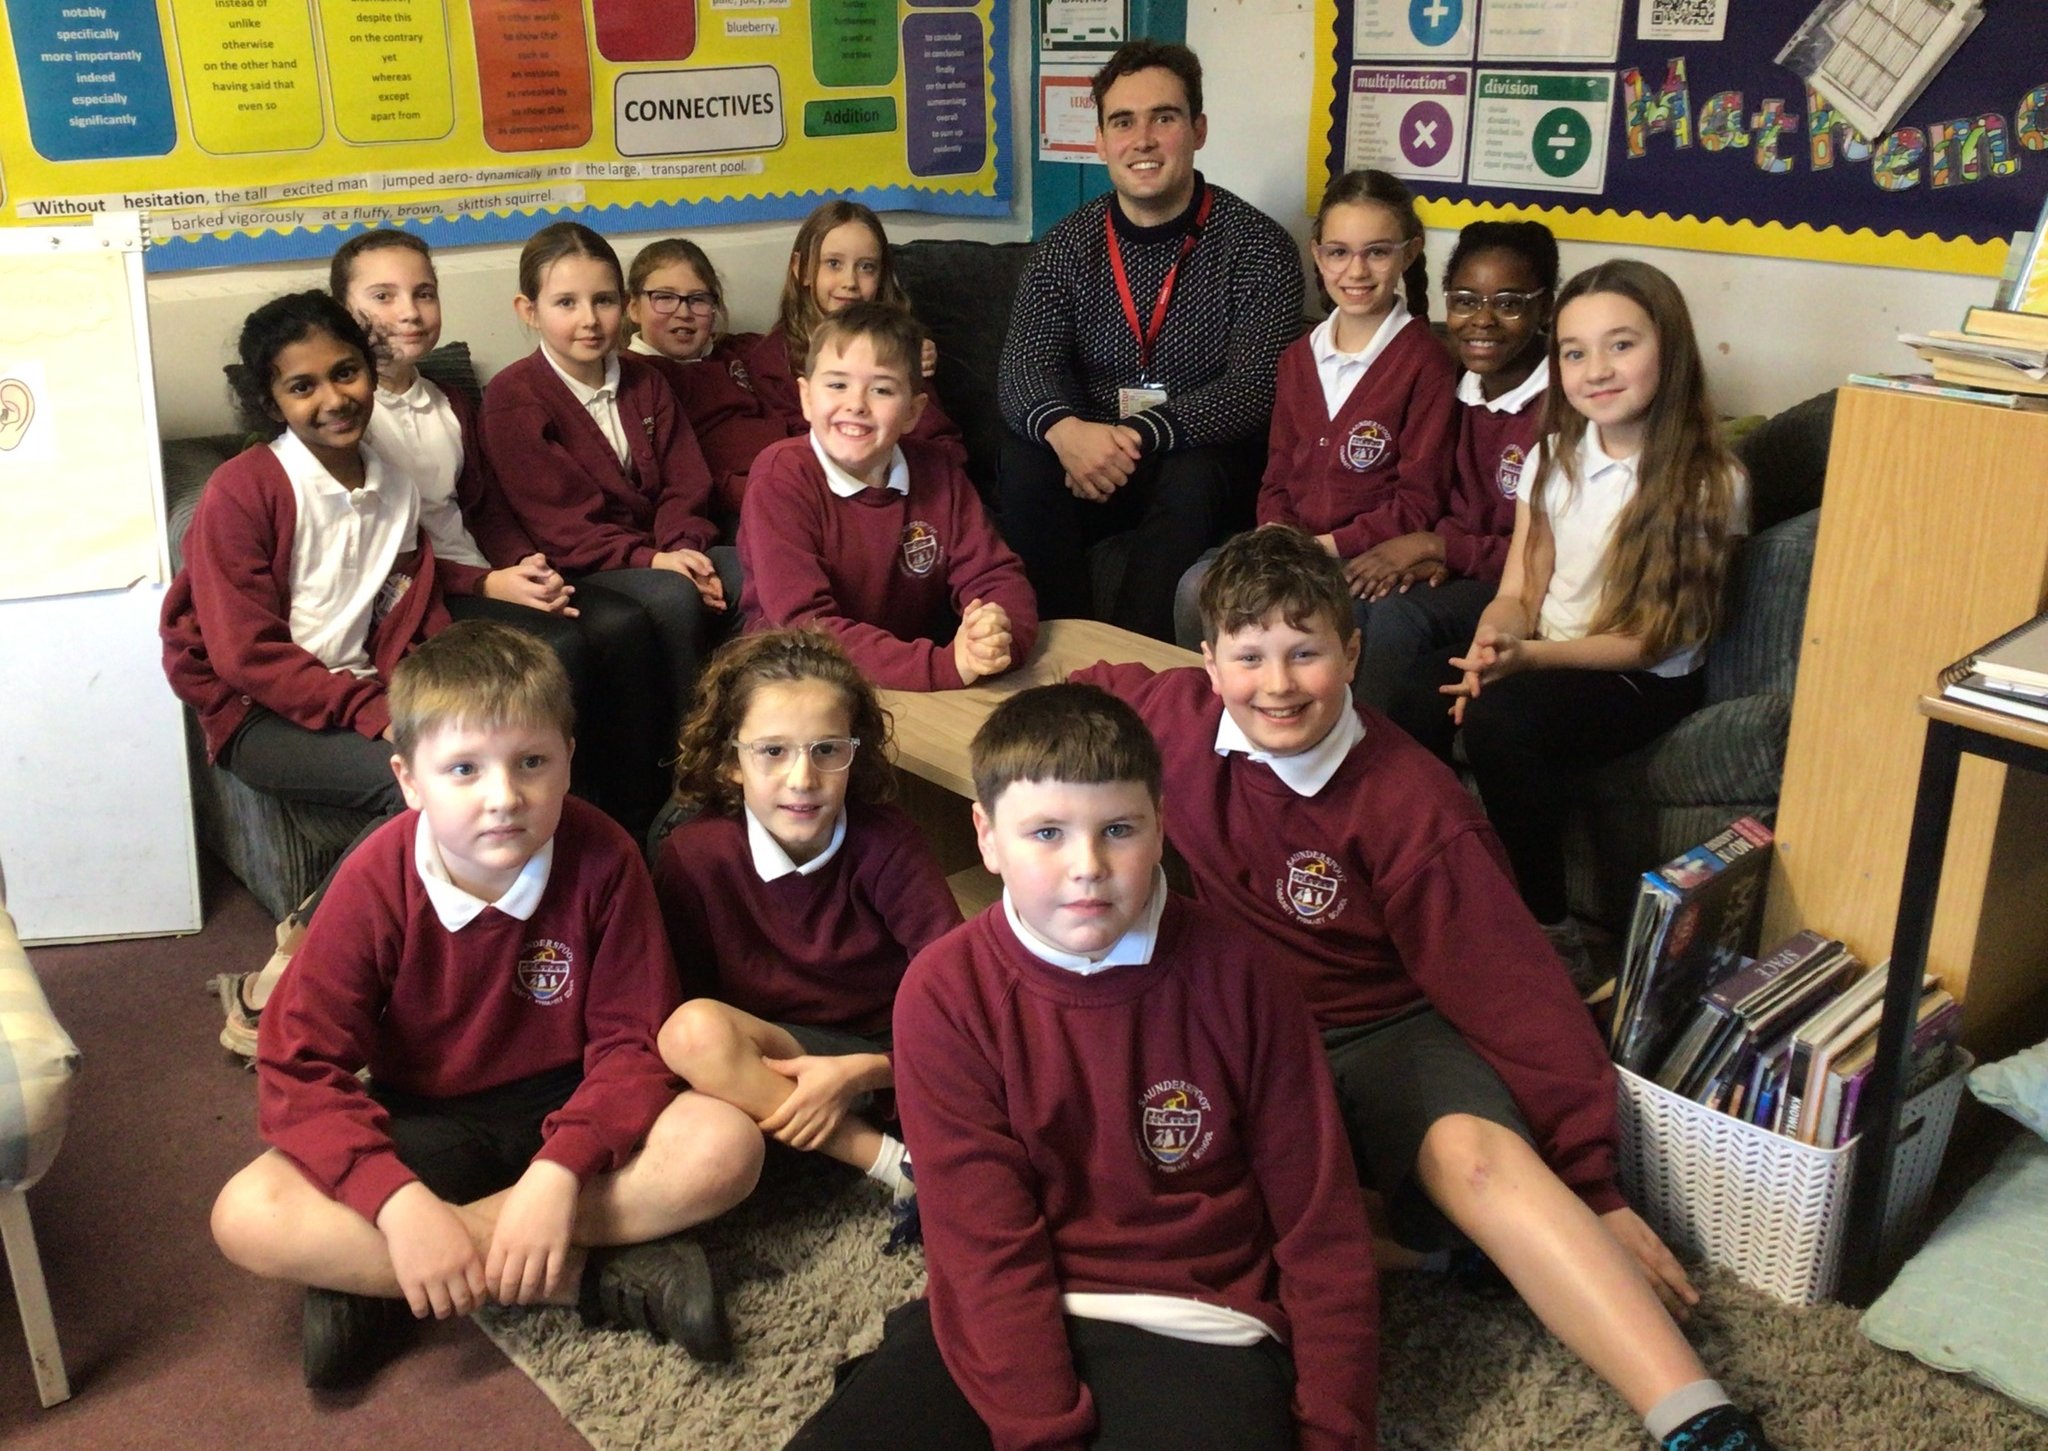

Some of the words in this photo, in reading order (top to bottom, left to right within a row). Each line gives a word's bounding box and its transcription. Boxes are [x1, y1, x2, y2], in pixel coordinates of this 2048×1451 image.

[62, 7, 106, 19] notably
[356, 13, 392, 23] despite
[394, 13, 412, 22] this
[228, 18, 261, 28] unlike
[727, 22, 778, 34] blueberry.
[57, 28, 119, 41] specifically
[349, 34, 362, 42] on
[365, 33, 381, 42] the
[383, 33, 423, 43] contrary
[222, 40, 274, 49] otherwise
[41, 52, 72, 62] more
[75, 50, 142, 63] importantly
[382, 54, 397, 63] yet
[203, 63, 218, 71] on
[220, 61, 238, 70] the
[241, 60, 268, 70] other
[272, 59, 297, 69] hand
[76, 72, 116, 83] indeed
[372, 73, 412, 82] whereas
[1357, 74, 1447, 92] multiplication
[212, 81, 248, 92] having
[250, 80, 271, 90] said
[273, 80, 295, 89] that
[1484, 78, 1538, 95] division
[72, 93, 127, 106] especially
[378, 92, 410, 102] except
[238, 102, 263, 111] even
[265, 102, 277, 110] so
[625, 93, 774, 122] CONNECTIVES
[69, 113, 137, 128] significantly
[371, 112, 396, 122] apart
[398, 111, 421, 120] from
[823, 108, 880, 125] Addition
[33, 199, 105, 216] Without
[123, 191, 210, 209] hesitation,
[215, 190, 241, 204] the
[245, 187, 268, 201] tall
[282, 180, 334, 197] excited
[338, 177, 368, 191] man
[382, 172, 435, 190] jumped
[476, 168, 542, 182] dynamically
[586, 162, 605, 176] the
[608, 163, 641, 177] large,
[651, 162, 717, 176] transparent
[720, 159, 747, 175] pool.
[172, 211, 224, 231] barked
[228, 209, 304, 228] vigorously
[322, 210, 336, 220] at
[340, 211, 348, 220] a
[353, 206, 393, 219] fluffy,
[398, 205, 444, 217] brown,
[458, 196, 502, 212] skittish
[1755, 949, 1801, 978] SPACE
